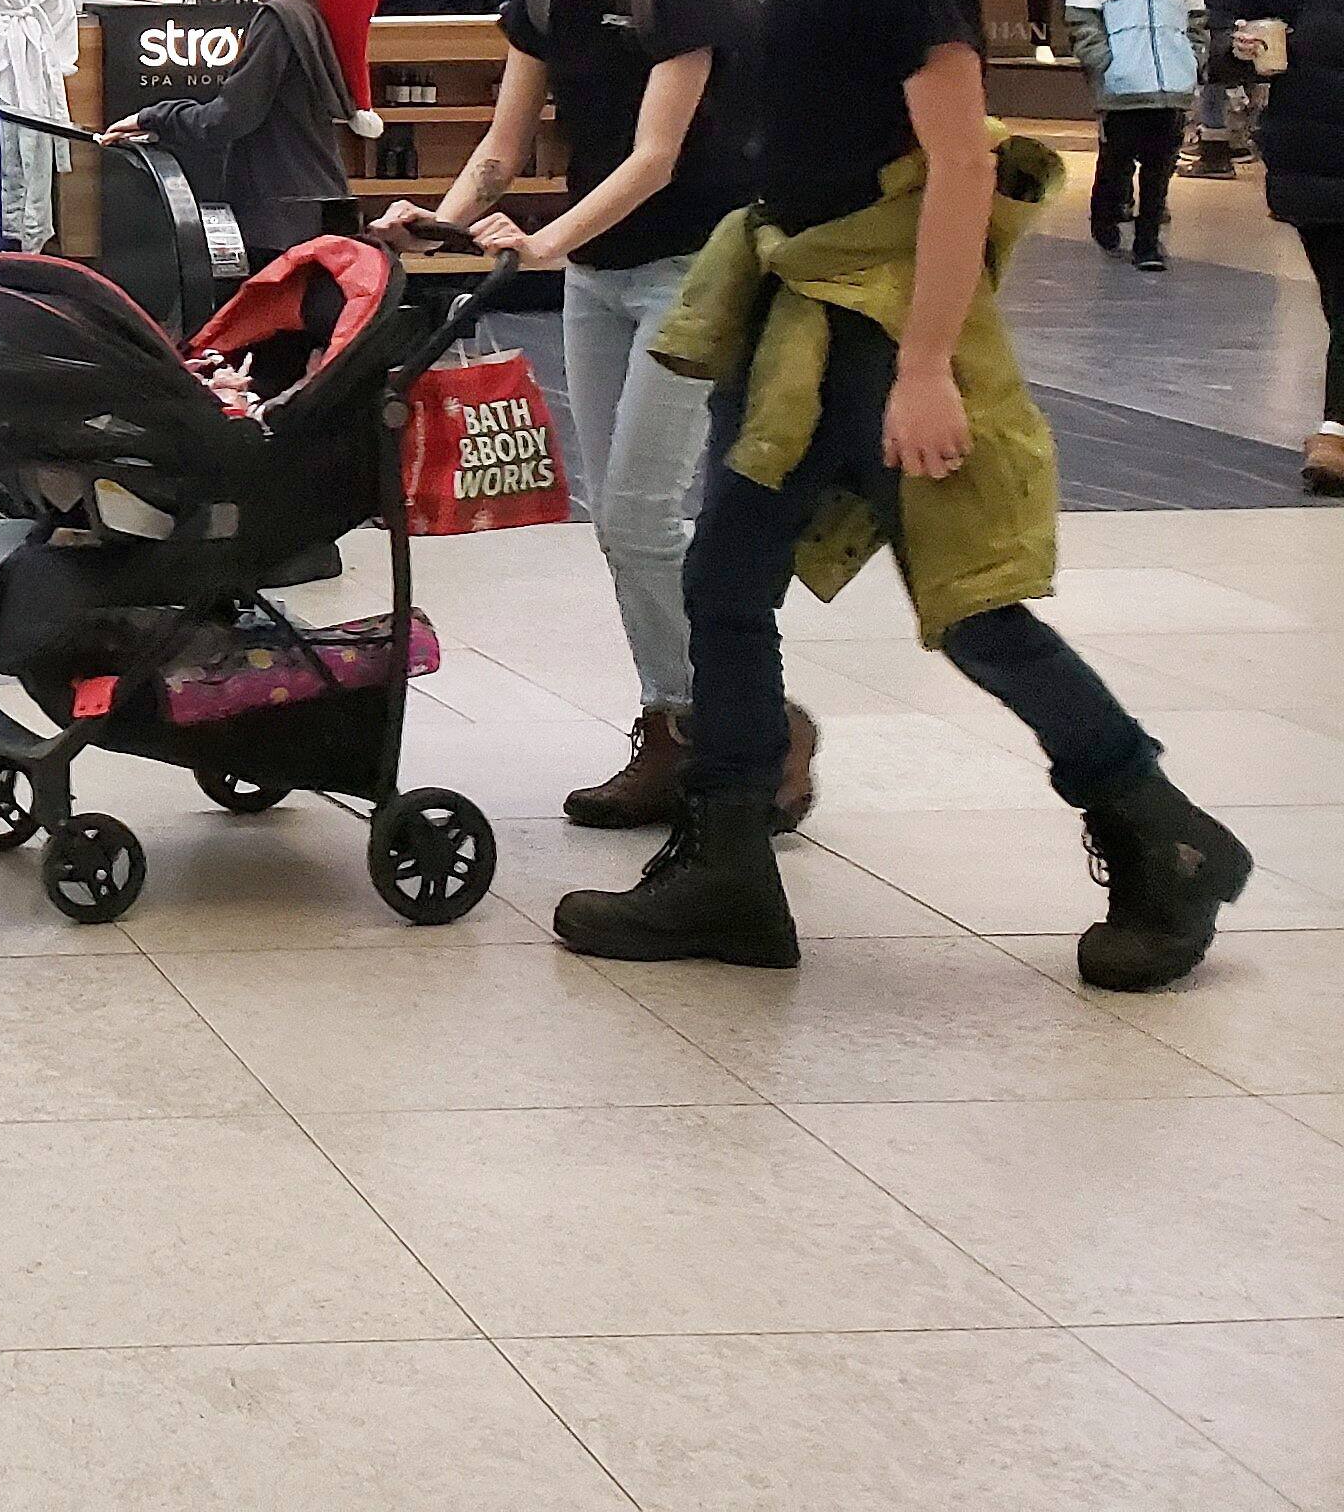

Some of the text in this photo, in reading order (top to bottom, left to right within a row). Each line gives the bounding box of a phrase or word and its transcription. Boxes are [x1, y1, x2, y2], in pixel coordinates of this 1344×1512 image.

[138, 18, 245, 68] strø
[139, 75, 173, 87] SPA
[462, 397, 532, 435] BATH
[452, 458, 555, 500] WORKS
